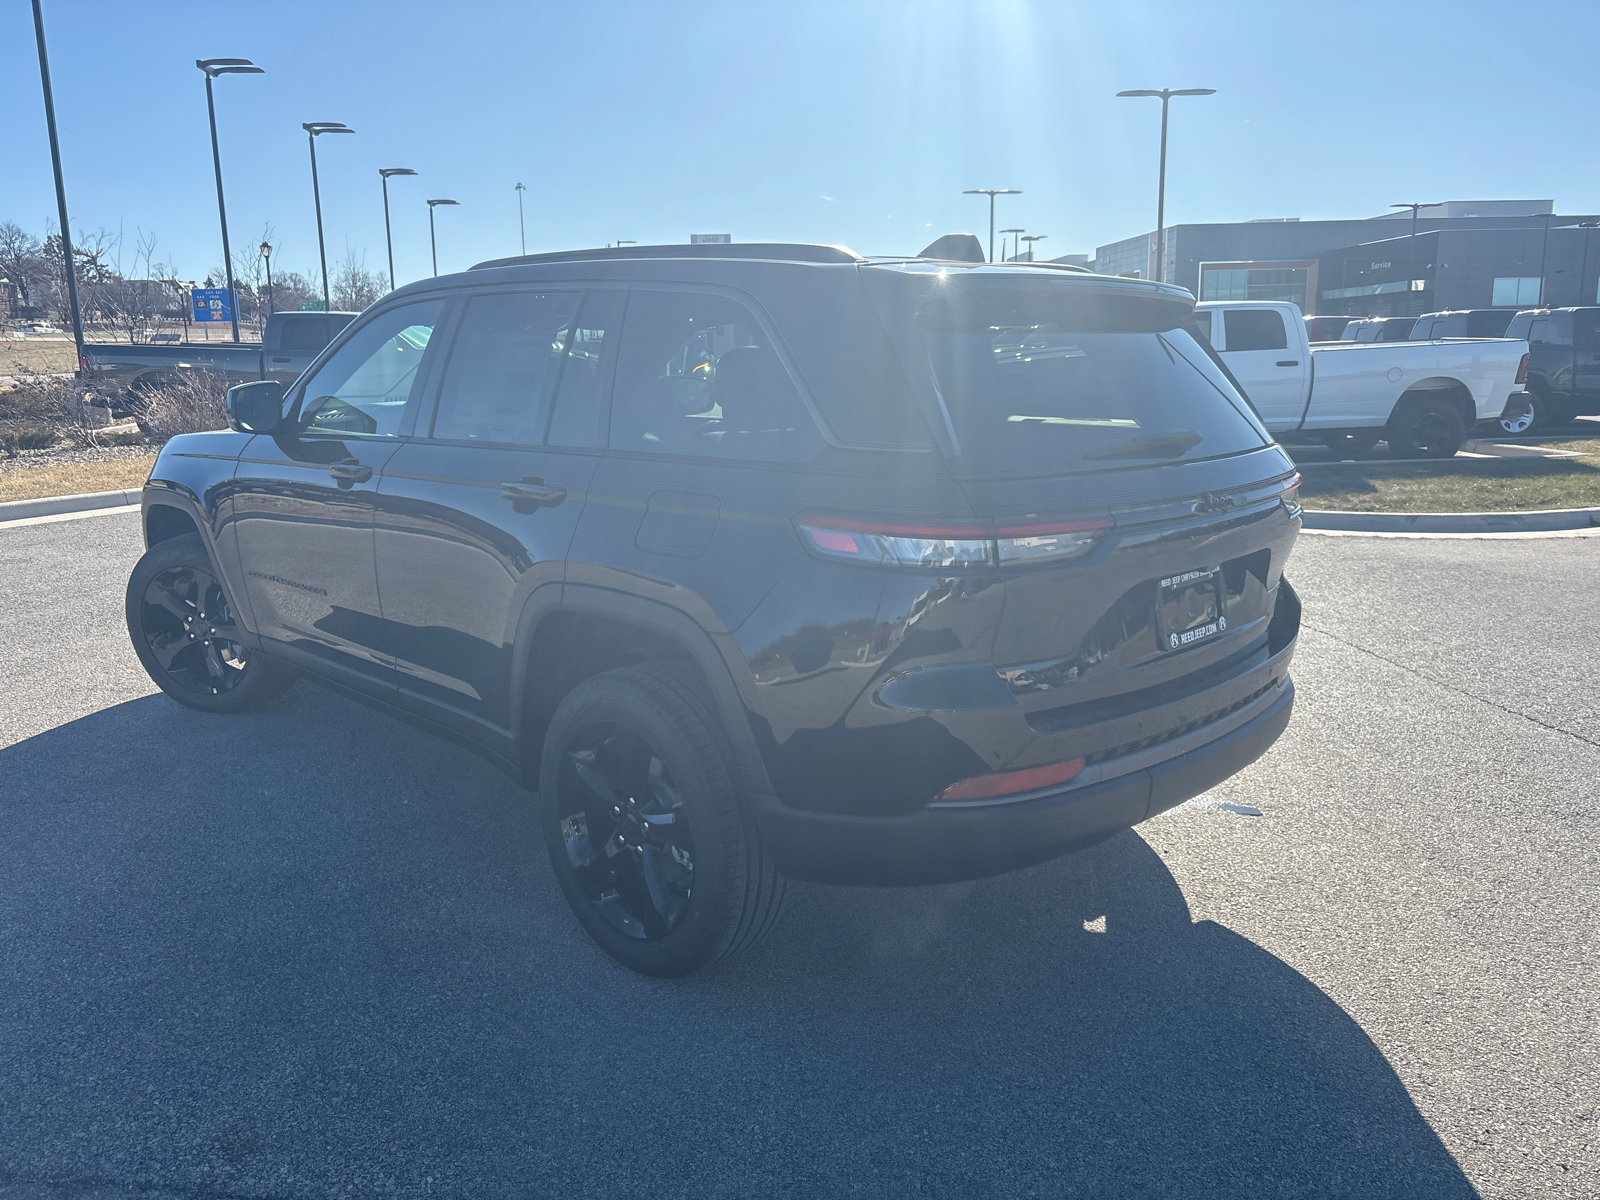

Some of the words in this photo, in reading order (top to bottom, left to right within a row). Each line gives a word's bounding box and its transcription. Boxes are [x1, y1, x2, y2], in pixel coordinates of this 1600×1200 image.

[1370, 261, 1392, 270] Service
[1161, 578, 1171, 588] REED
[1172, 575, 1180, 584] JEEP
[1180, 622, 1217, 645] REEDJEEP.COM
